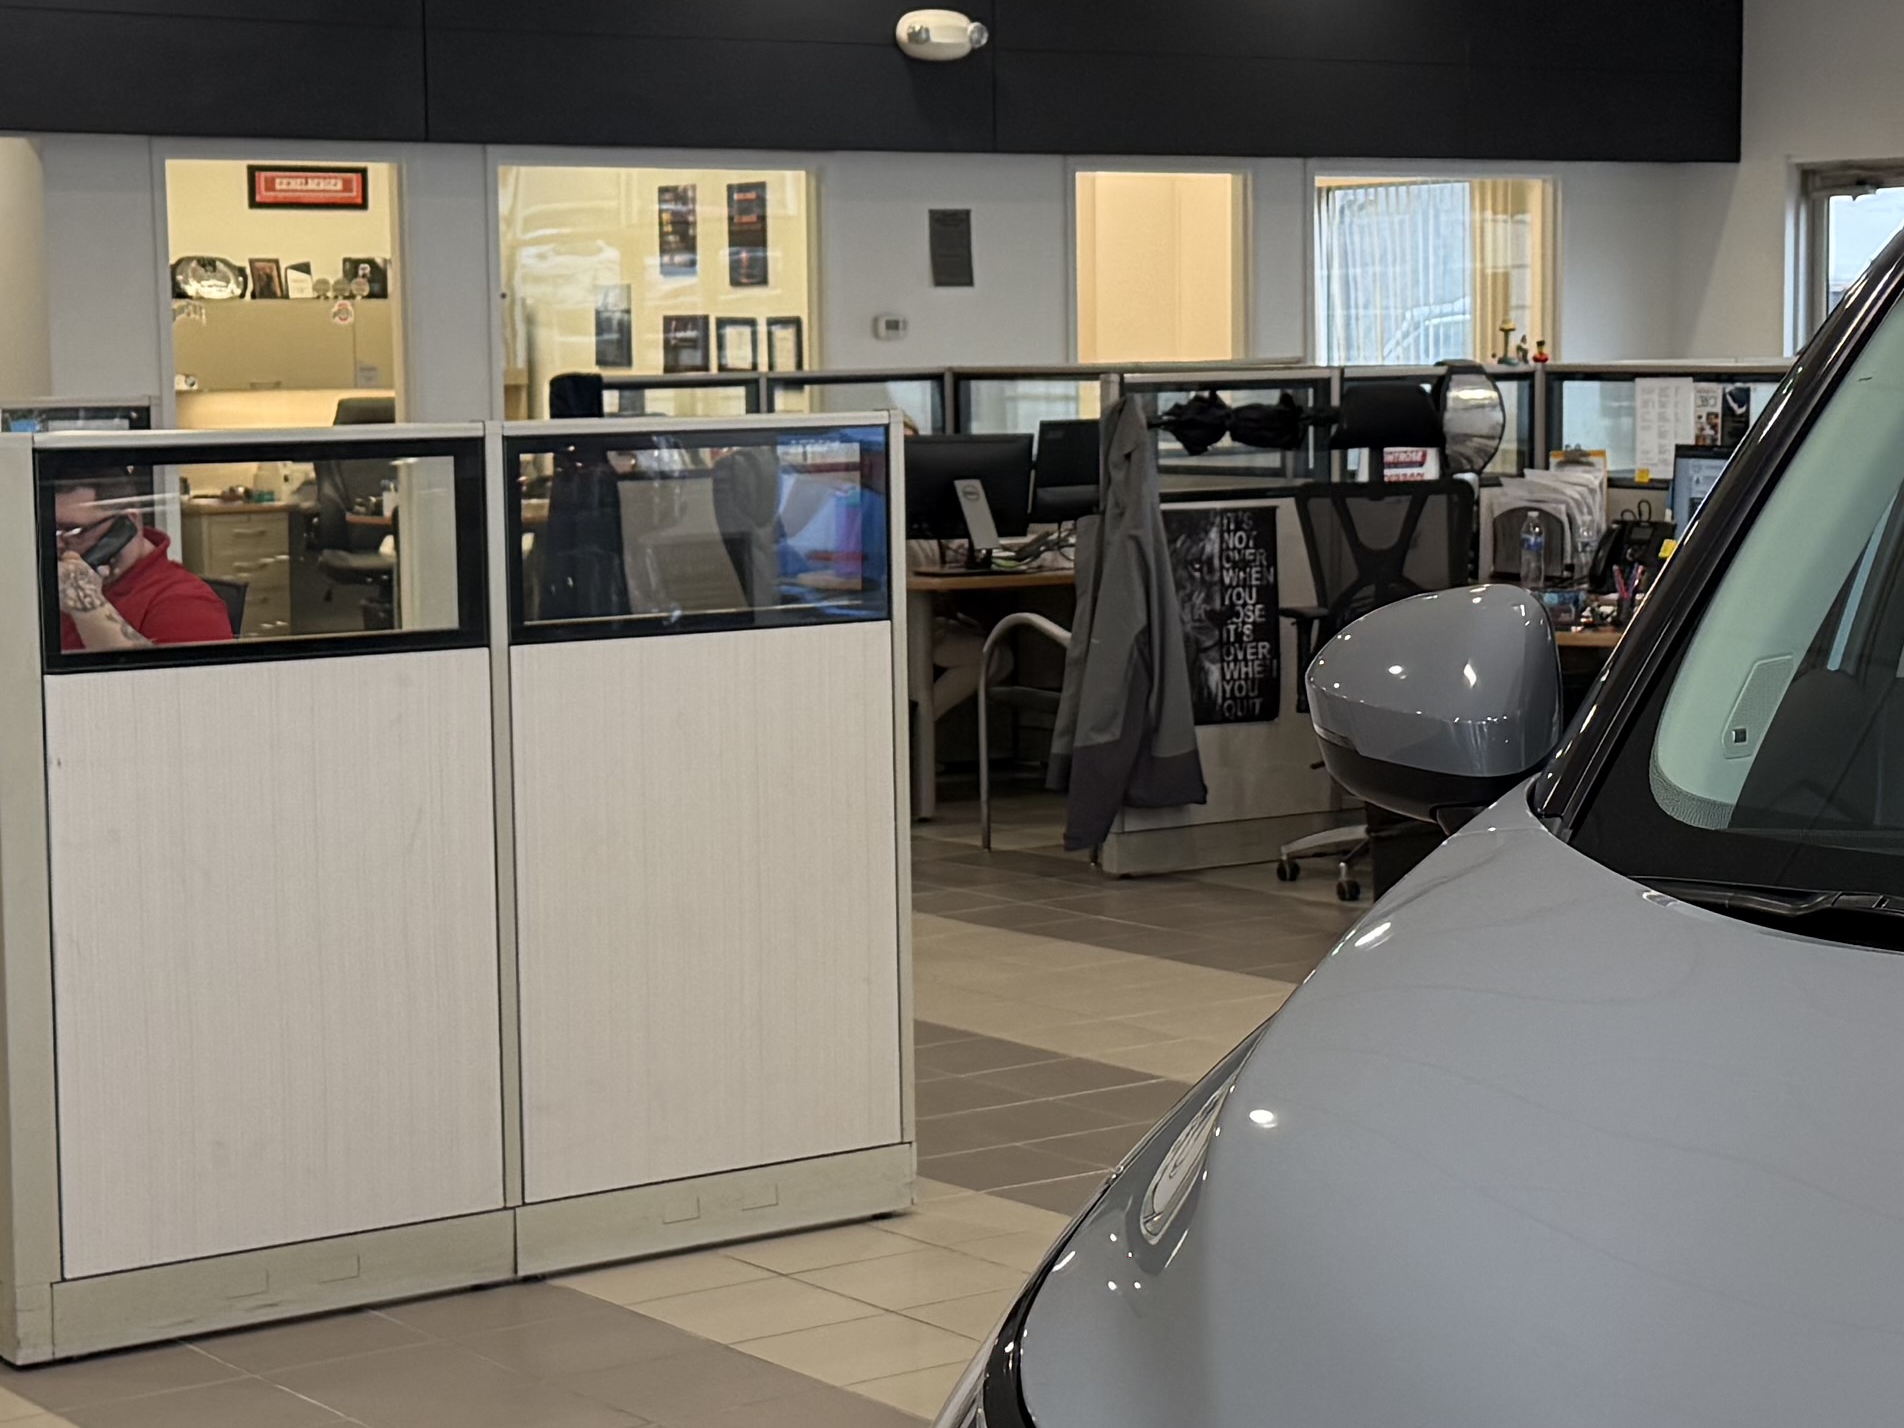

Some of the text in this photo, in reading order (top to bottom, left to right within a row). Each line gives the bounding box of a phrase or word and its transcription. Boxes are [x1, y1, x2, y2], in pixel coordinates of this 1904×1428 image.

[1222, 512, 1253, 530] IT'S
[1222, 531, 1257, 549] NOT
[1222, 549, 1267, 568] OVER
[1222, 567, 1274, 586] WHEN
[1224, 587, 1256, 605] YOU
[1227, 604, 1265, 623] OSE
[1222, 622, 1253, 642] IT'S
[1222, 641, 1270, 661] OVER
[1222, 679, 1258, 698] YOU
[1222, 697, 1262, 719] QUIT
